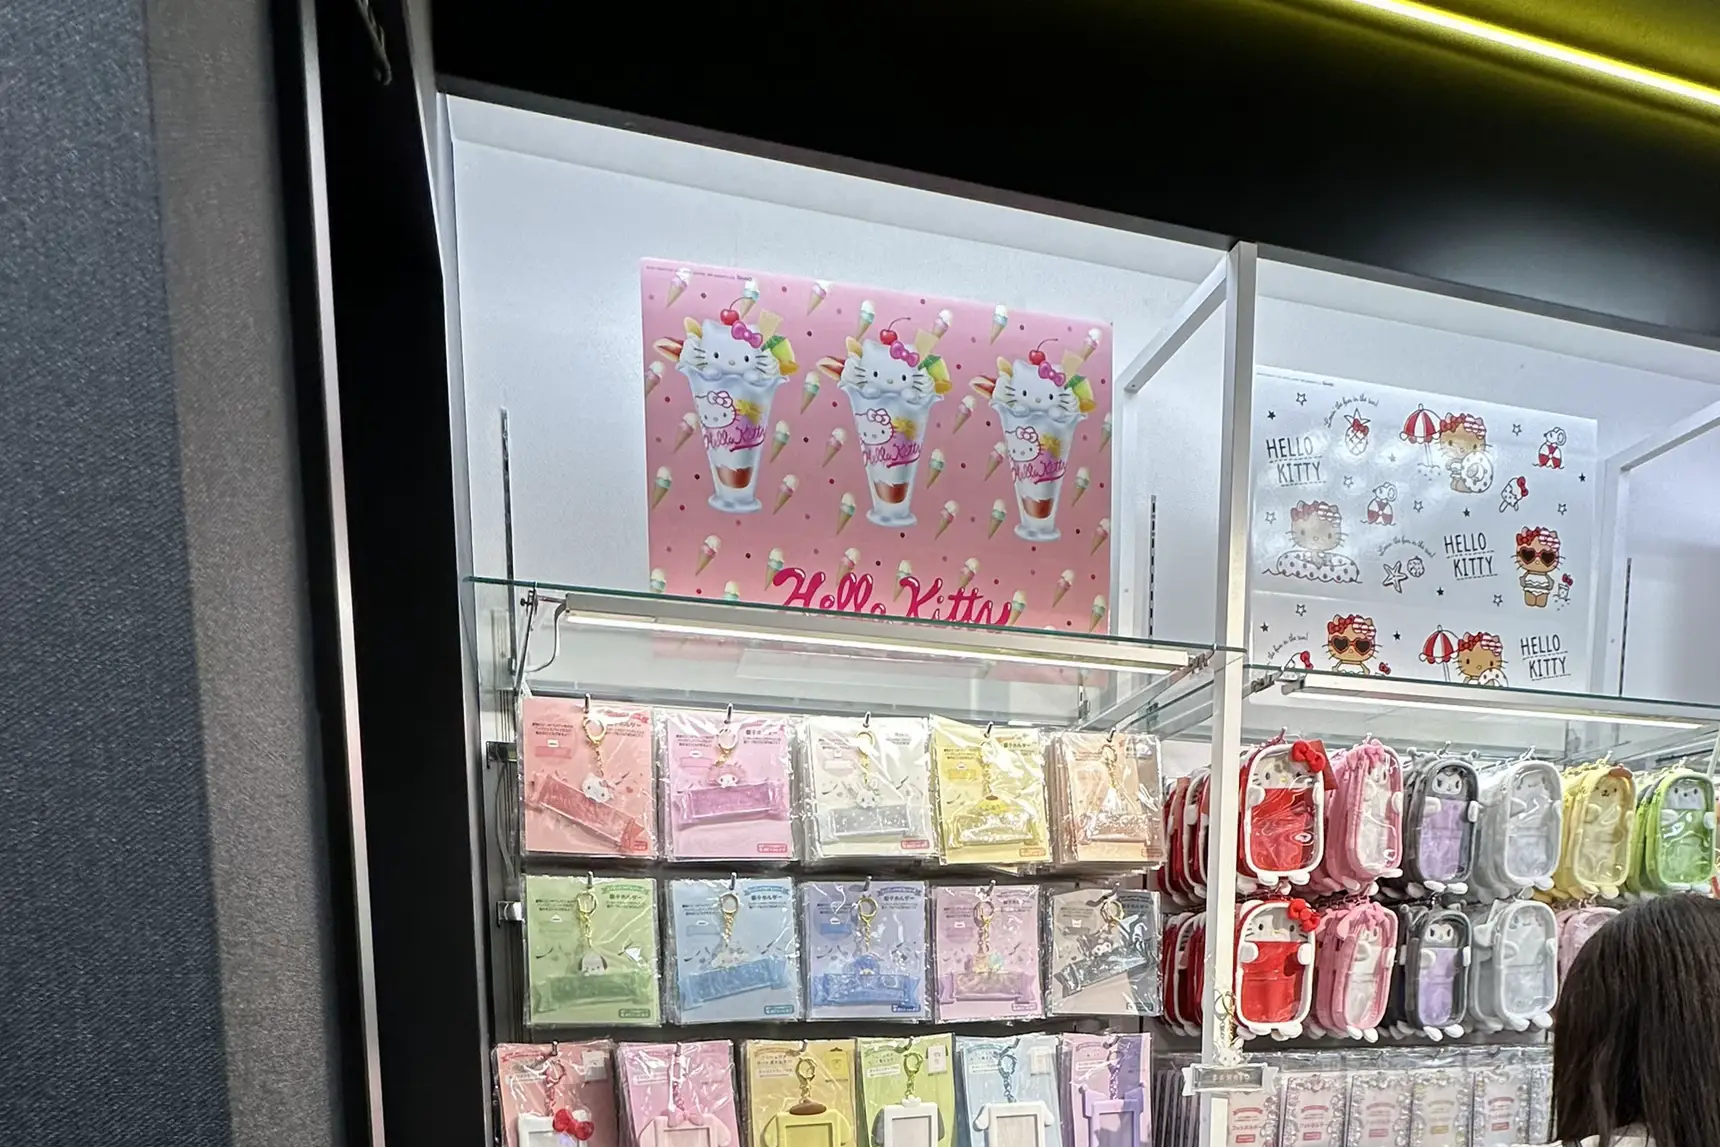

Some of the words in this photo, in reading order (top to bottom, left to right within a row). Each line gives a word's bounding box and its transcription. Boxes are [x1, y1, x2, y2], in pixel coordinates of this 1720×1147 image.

[1265, 435, 1314, 459] HELLO
[1277, 461, 1321, 484] KITTY
[1443, 532, 1487, 554] HELLO
[1453, 556, 1493, 578] KITTY
[1520, 633, 1561, 656] HELLO
[1528, 656, 1567, 679] KITTY
